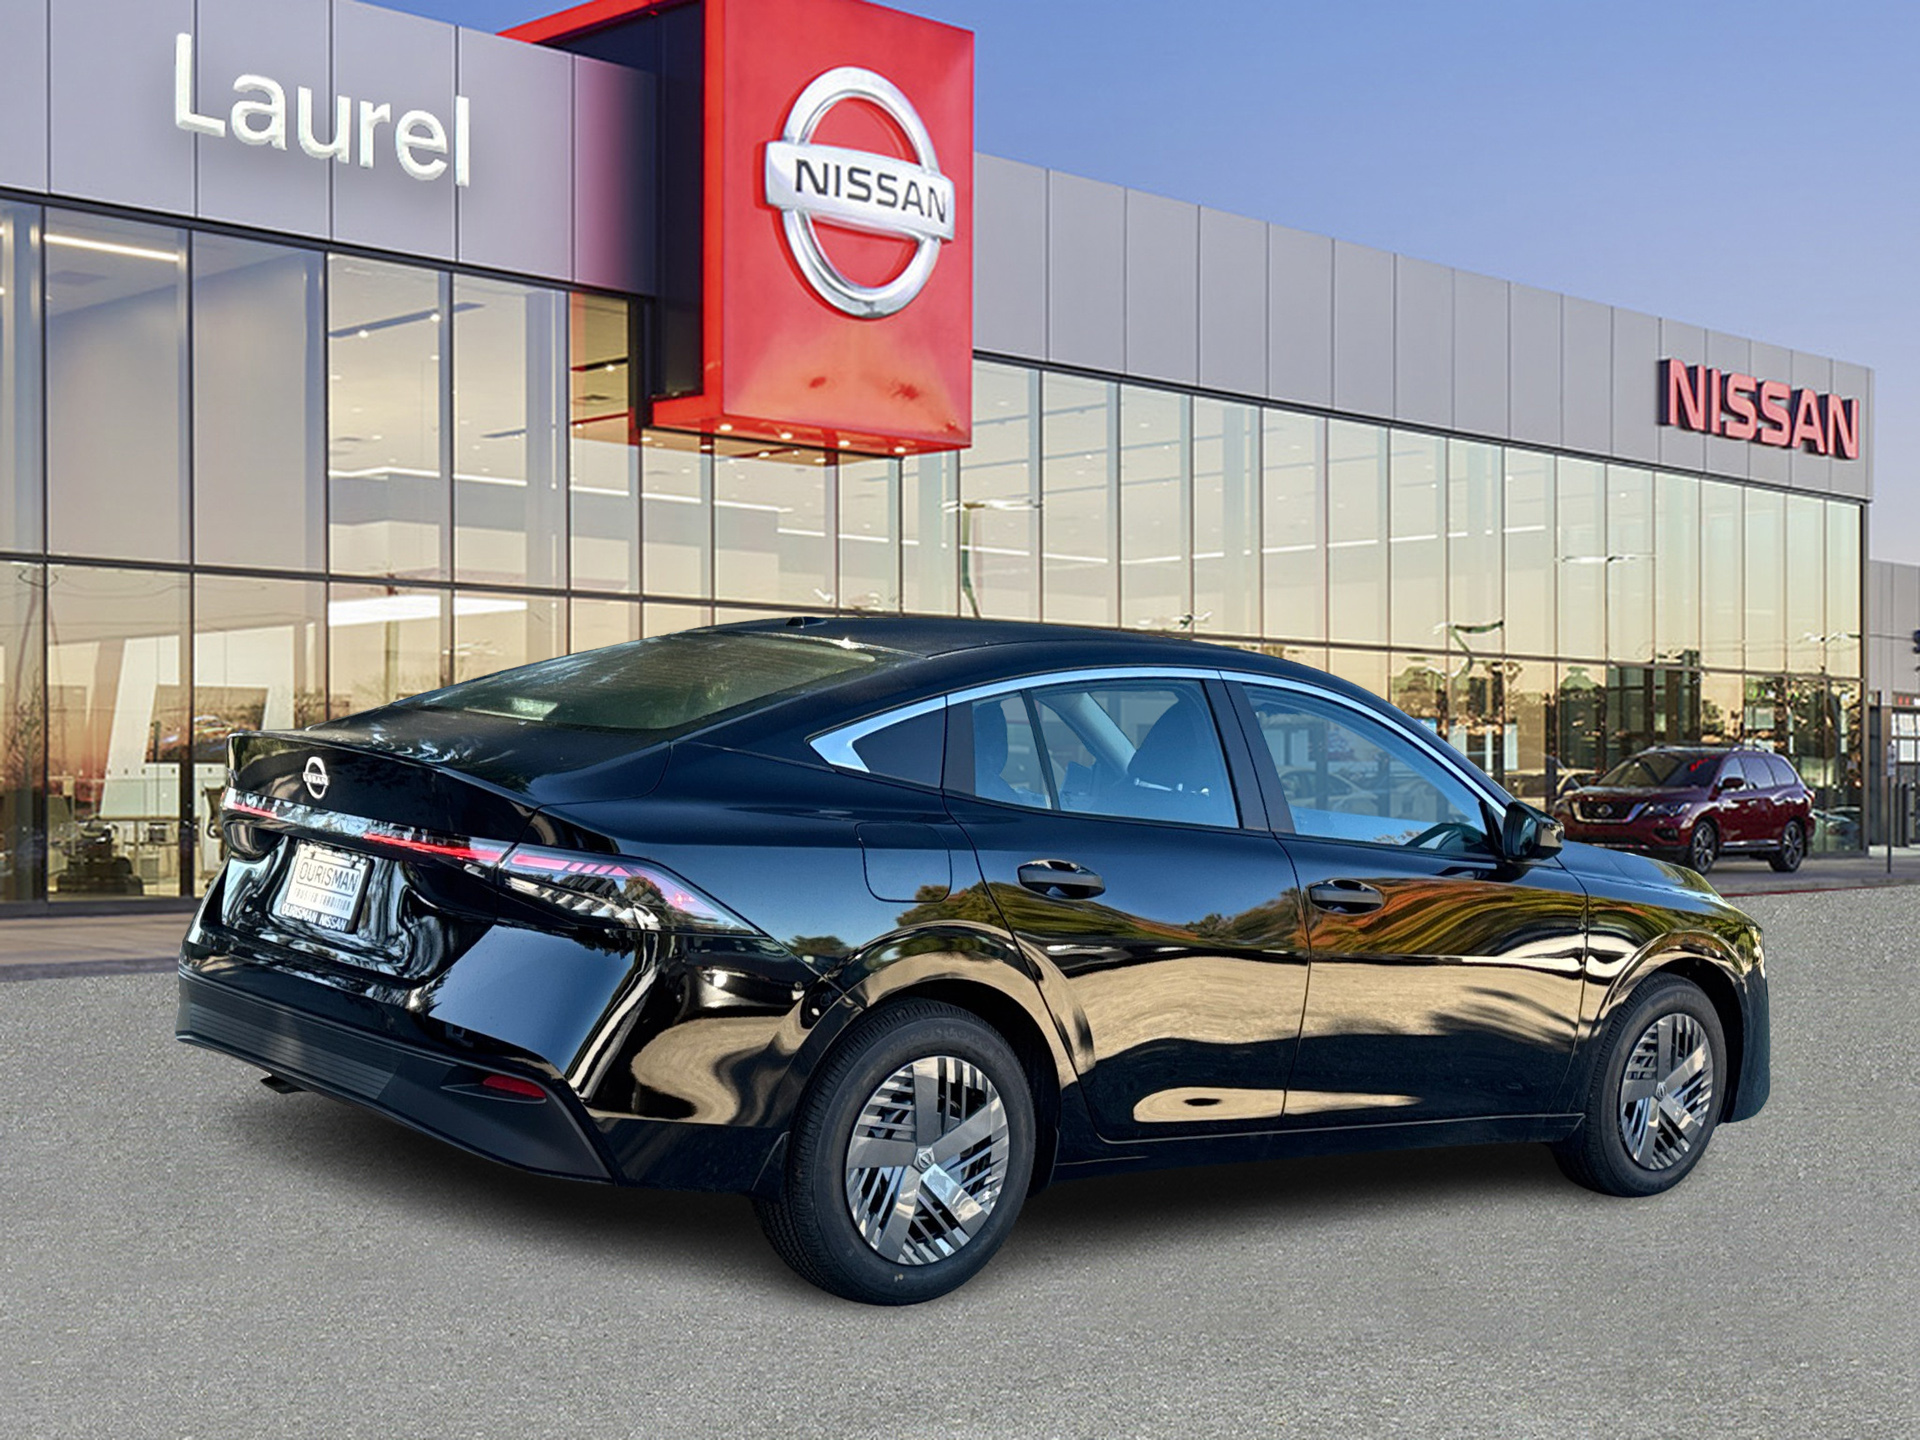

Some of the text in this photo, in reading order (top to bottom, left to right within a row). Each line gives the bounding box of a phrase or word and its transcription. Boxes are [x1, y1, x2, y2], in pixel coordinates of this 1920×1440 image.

[175, 33, 470, 188] Laurel
[795, 159, 946, 224] NISSAN
[1660, 358, 1860, 460] NISSAN
[300, 862, 359, 892] OURISMAN
[282, 903, 348, 931] OURISMAN NISSAN
